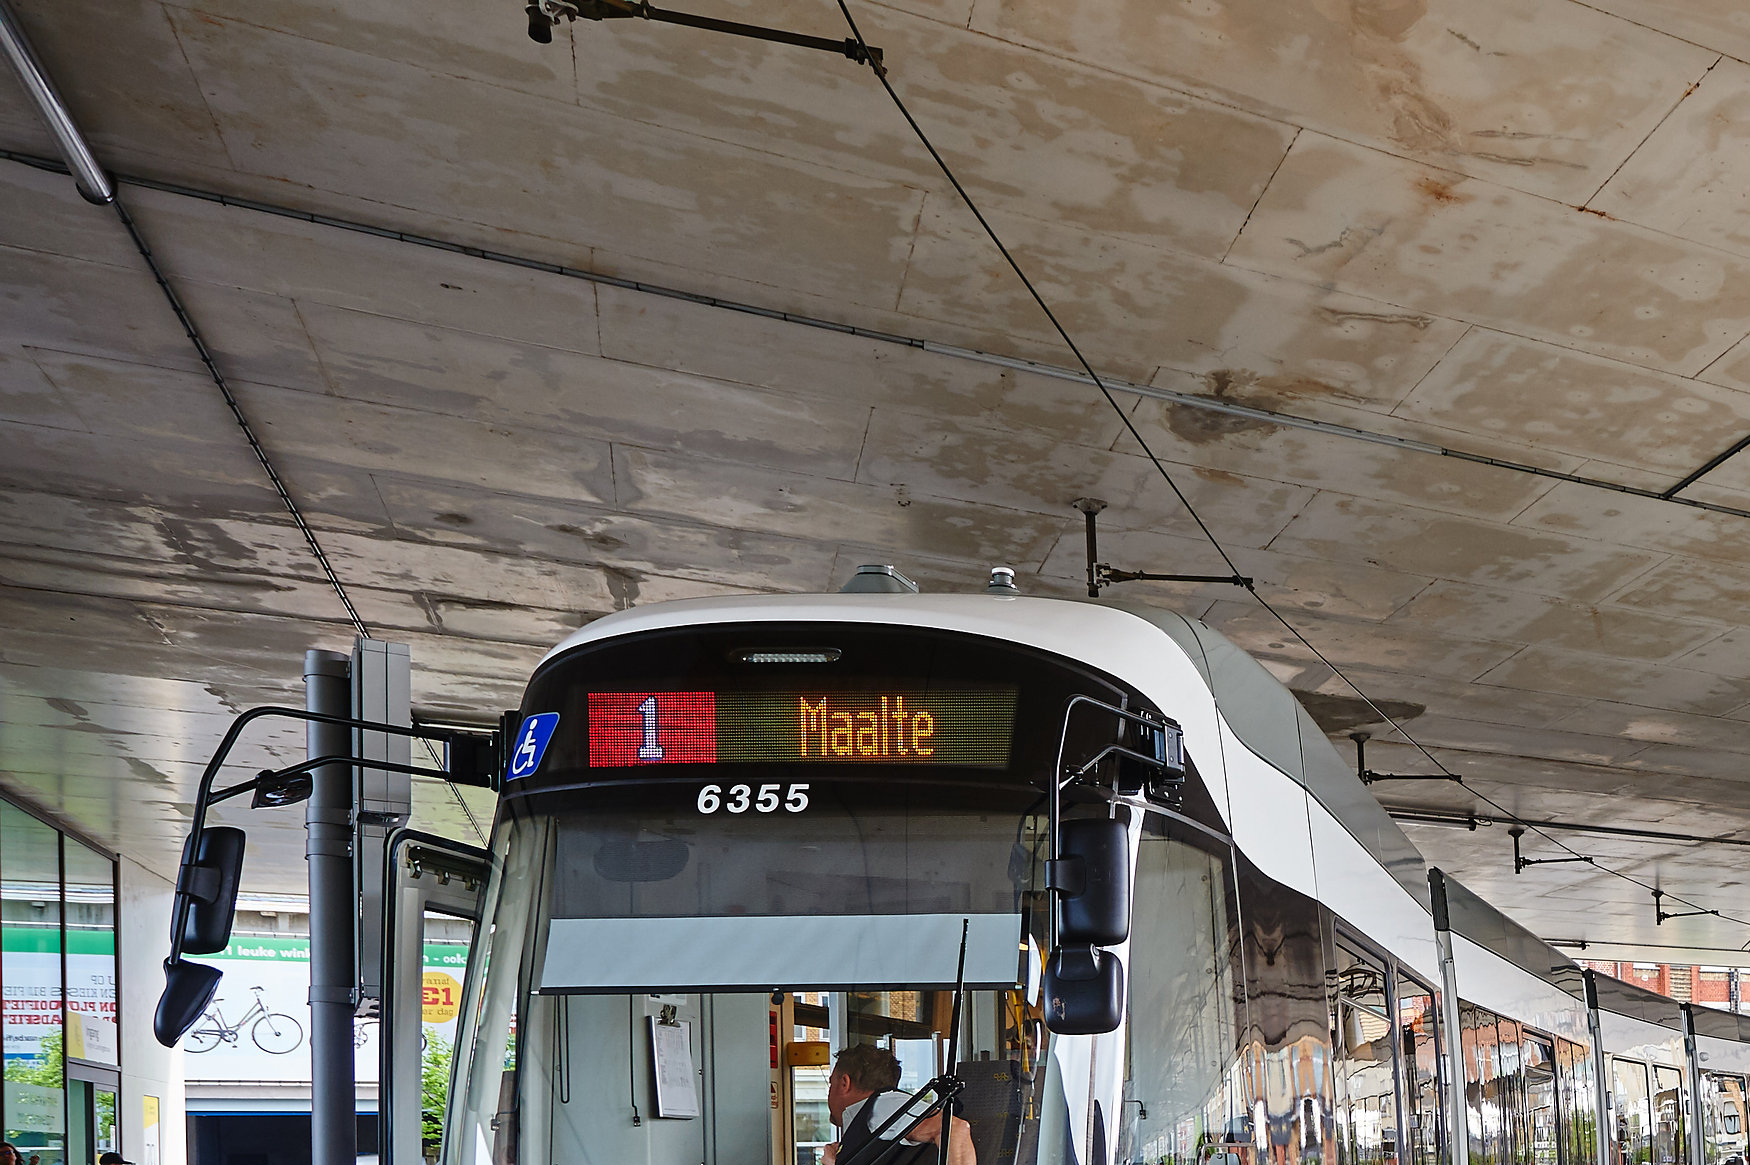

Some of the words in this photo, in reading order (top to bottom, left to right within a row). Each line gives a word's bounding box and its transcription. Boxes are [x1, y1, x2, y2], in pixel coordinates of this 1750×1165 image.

[637, 696, 665, 761] 1
[799, 695, 934, 756] Maalte
[697, 784, 810, 814] 6355
[237, 945, 277, 958] leuke
[437, 1007, 454, 1016] dag
